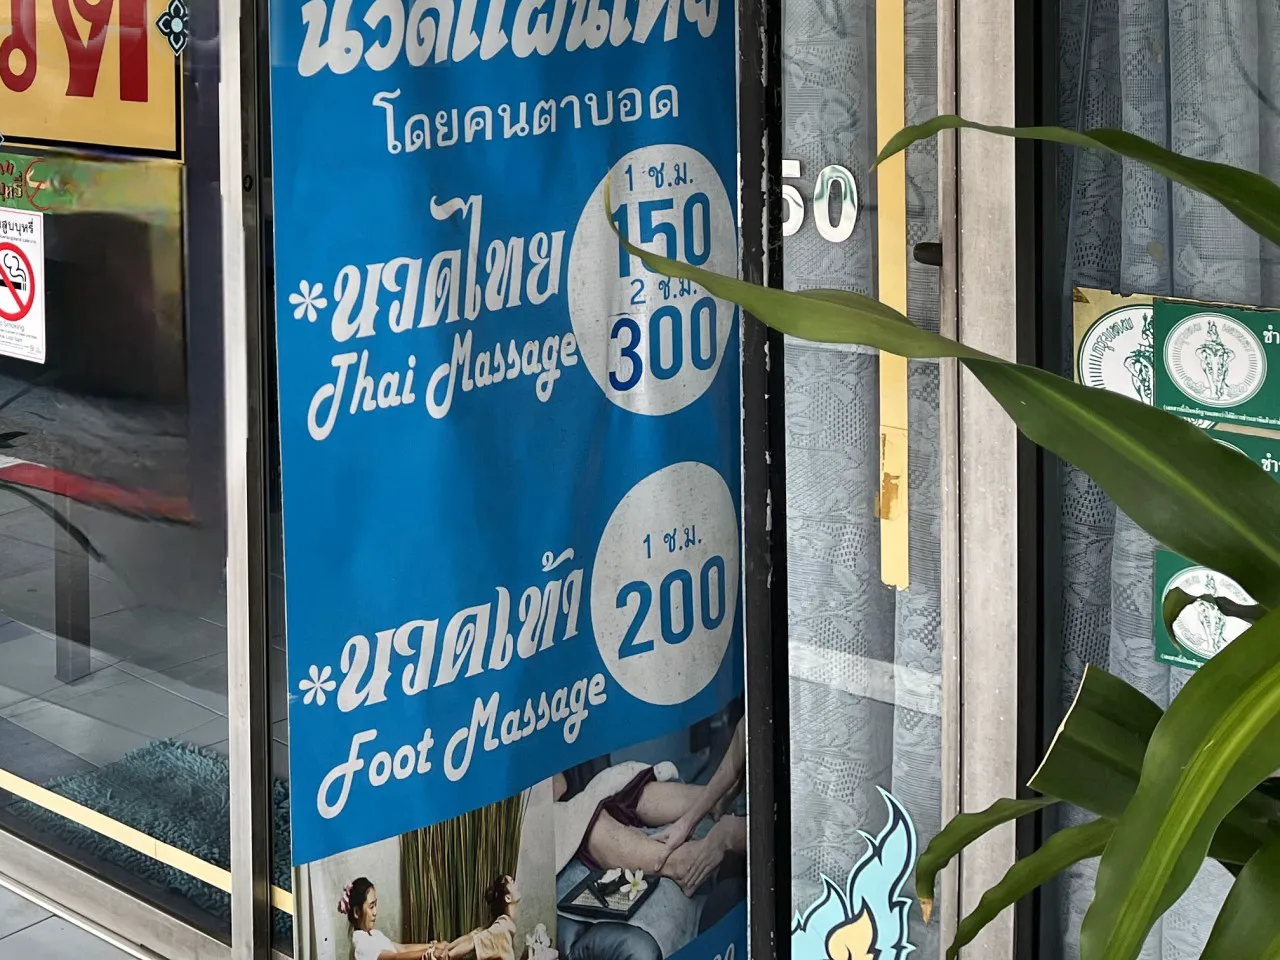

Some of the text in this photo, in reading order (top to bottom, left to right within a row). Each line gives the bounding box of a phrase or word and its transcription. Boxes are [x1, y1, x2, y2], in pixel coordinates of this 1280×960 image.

[372, 85, 680, 155] โดยคนตาบอด
[624, 161, 694, 192] 1 ช.ม.
[782, 159, 858, 243] 50
[611, 191, 712, 278] 150
[630, 278, 646, 305] 2
[306, 329, 580, 441] Thai Massage
[608, 296, 718, 392] 300
[641, 525, 703, 559] 1 ช.ม.
[614, 554, 727, 660] 200
[316, 672, 608, 820] Foot Massage
